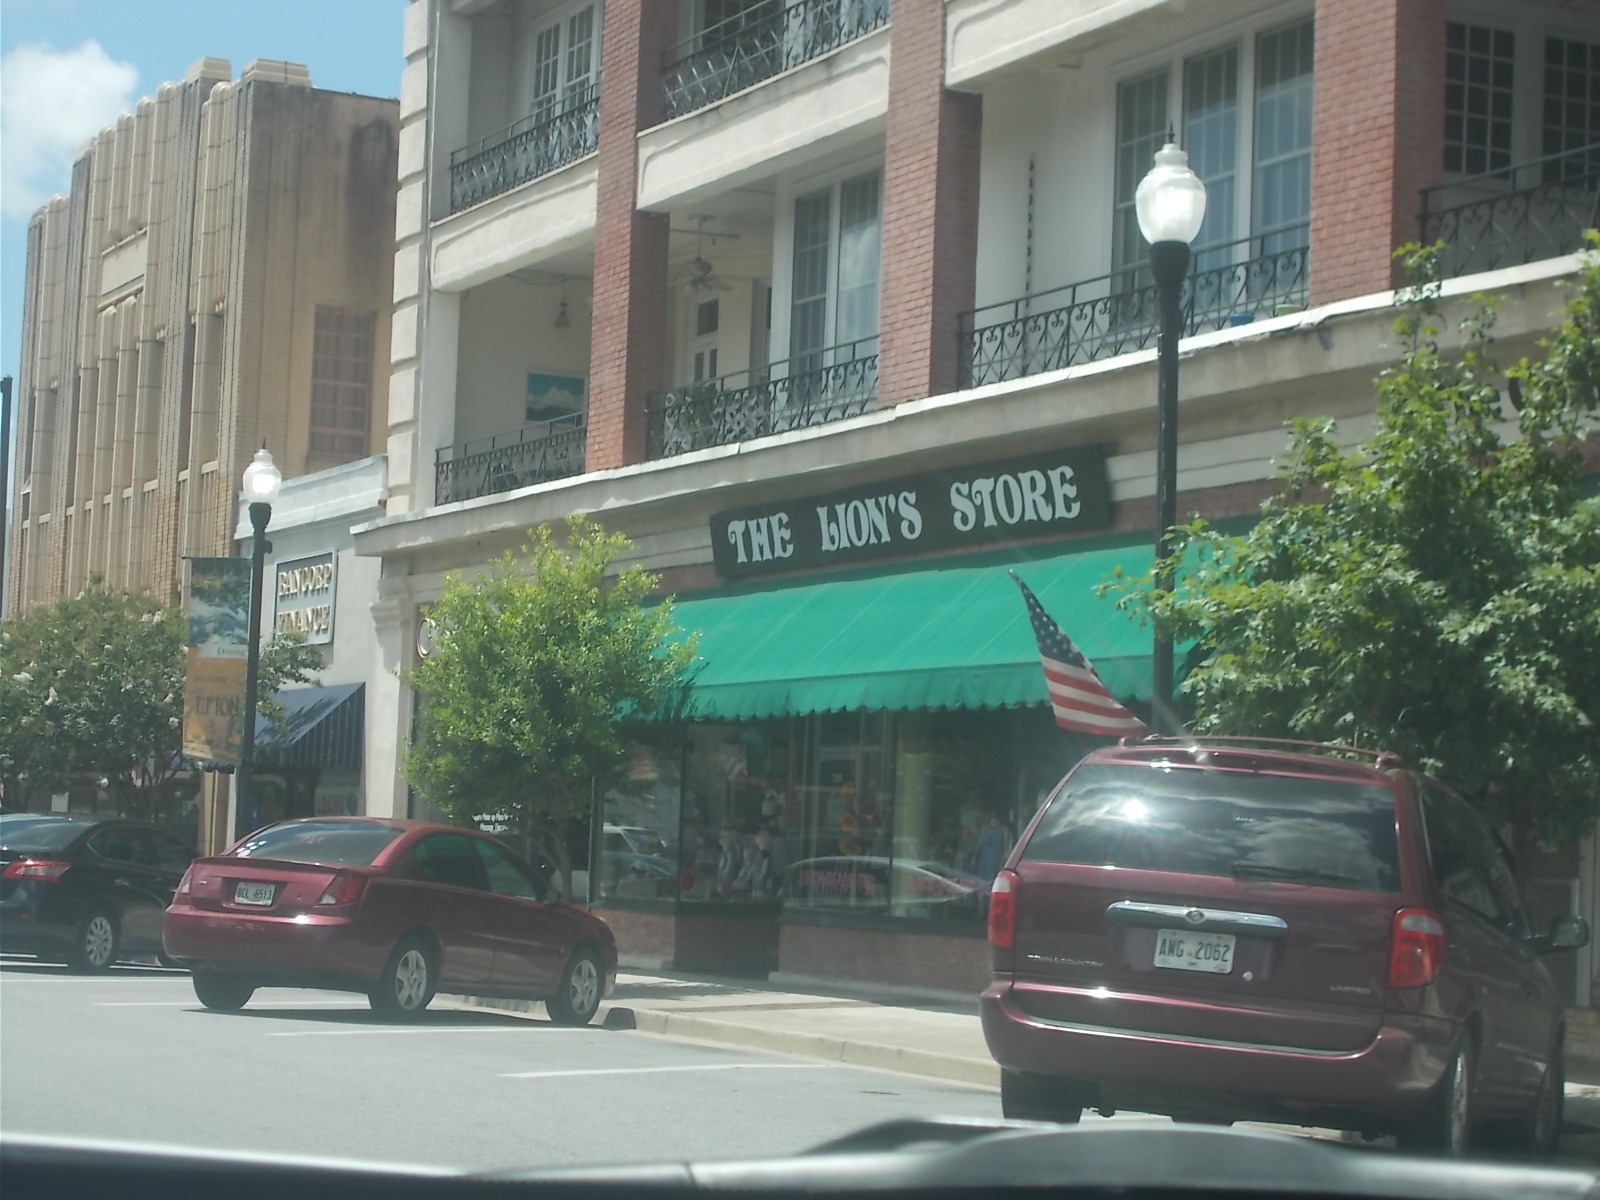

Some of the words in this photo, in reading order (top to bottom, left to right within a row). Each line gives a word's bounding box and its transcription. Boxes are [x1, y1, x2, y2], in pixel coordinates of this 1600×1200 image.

[727, 512, 794, 564] THE
[816, 490, 923, 552] LION'S
[949, 465, 1081, 532] STORE
[278, 563, 332, 596] BANCORP
[276, 605, 330, 634] FINANCE
[195, 695, 240, 716] TIFTON
[1195, 943, 1231, 962] 2062
